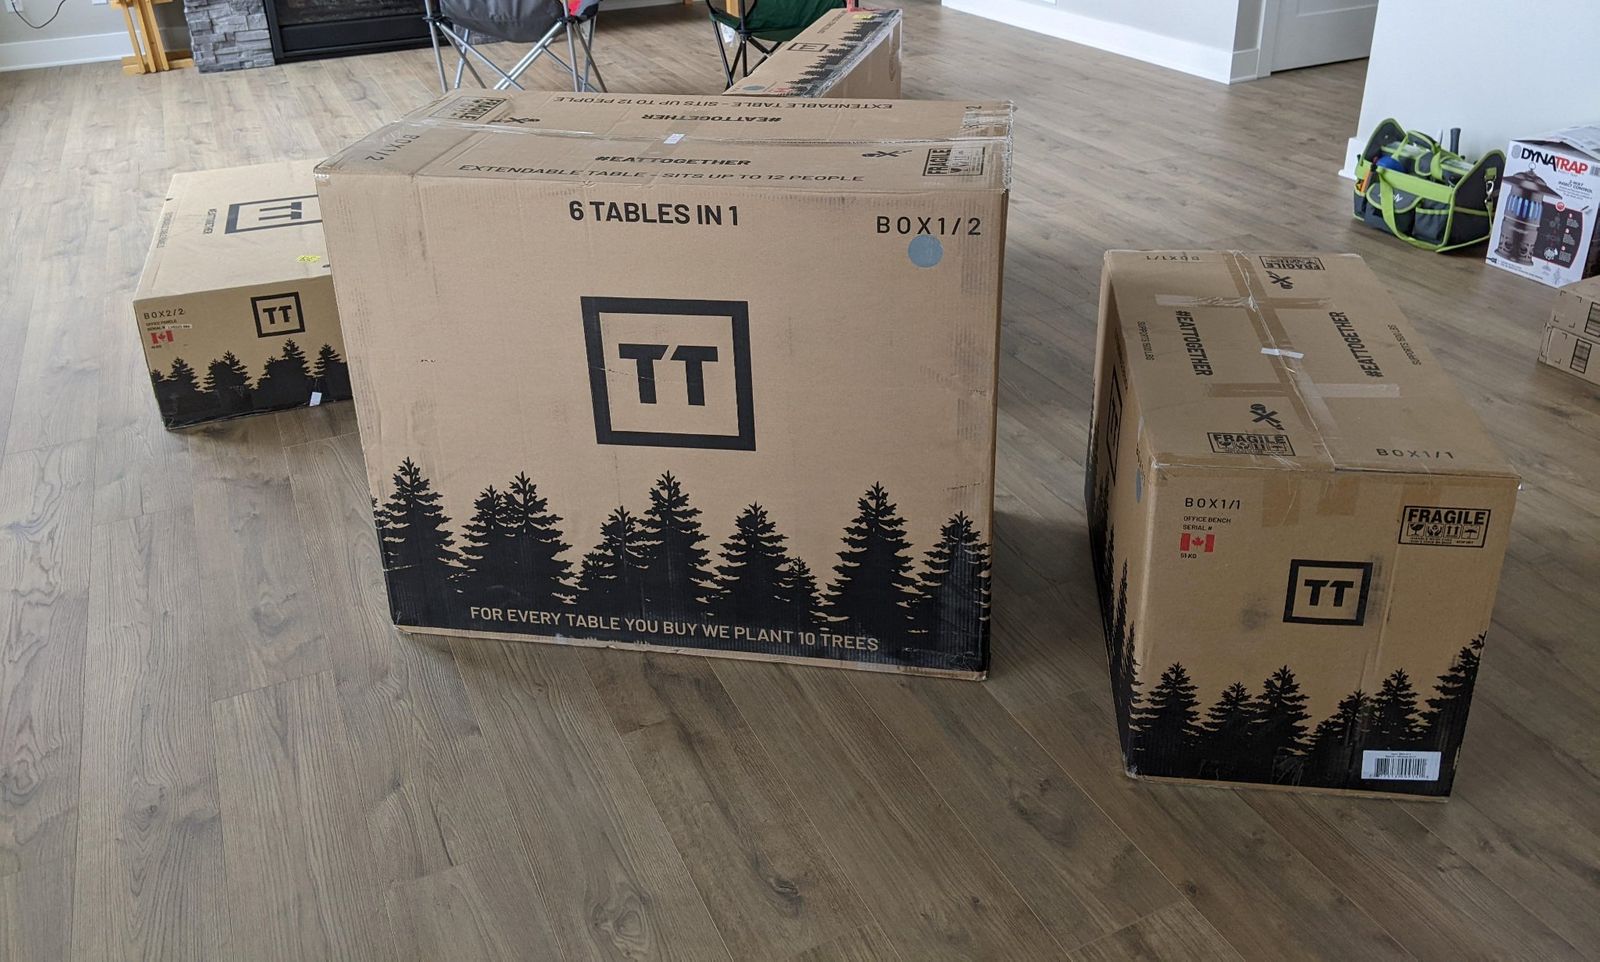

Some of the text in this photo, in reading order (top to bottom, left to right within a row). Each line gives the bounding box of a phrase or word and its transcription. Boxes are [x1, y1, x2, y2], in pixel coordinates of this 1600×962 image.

[554, 96, 615, 104] PEOPLE
[642, 113, 782, 122] #EATTOGETHER
[595, 156, 751, 165] #EATTOGETHER
[1521, 148, 1588, 174] DYNATRAP
[459, 164, 583, 176] EXTENDABLE
[588, 170, 647, 178] TABLE
[568, 200, 738, 226] 6 TABLES IN 1
[1265, 261, 1320, 270] FRAGILE
[262, 304, 292, 325] TT
[1175, 310, 1213, 376] #EATTOGETHER
[1328, 311, 1384, 377] #EATTOGETHER
[618, 343, 718, 406] TT
[1212, 434, 1286, 444] FRAGILE
[1183, 515, 1207, 523] OFFICE
[1408, 508, 1486, 525] FRAGILE
[1303, 579, 1354, 607] TT
[470, 606, 879, 651] FOR EVERY TABLE YOU BUY WE PLANT 10 TREES
